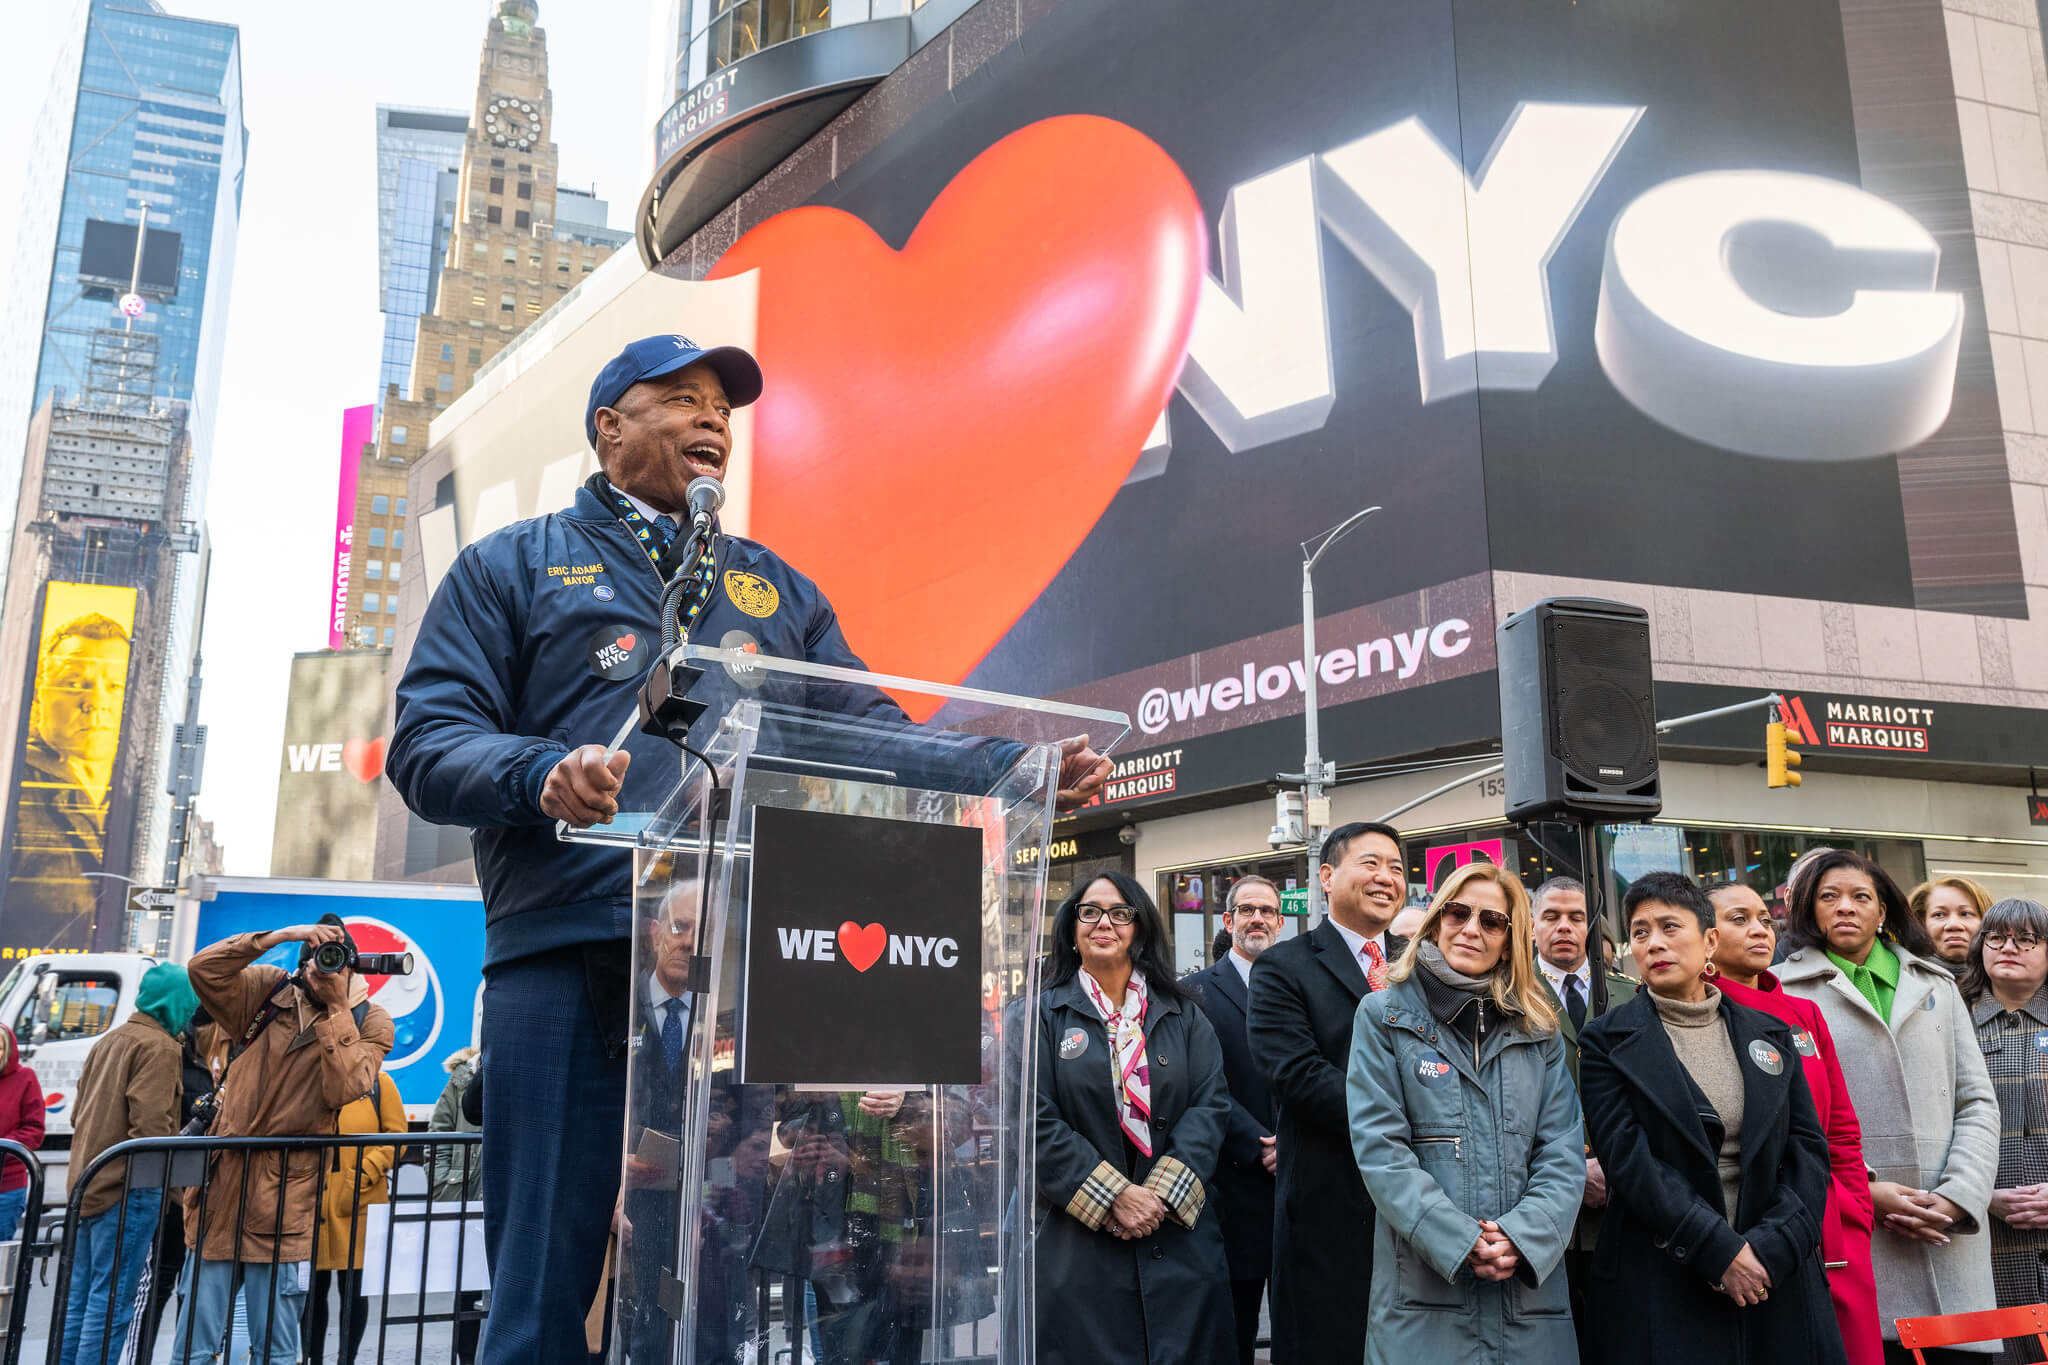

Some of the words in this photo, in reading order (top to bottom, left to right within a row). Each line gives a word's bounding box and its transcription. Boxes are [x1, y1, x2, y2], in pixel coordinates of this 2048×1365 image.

[662, 68, 738, 132] MARRIOTT
[661, 96, 725, 154] MARQUIS
[1120, 101, 1964, 463] NYC
[547, 565, 570, 577] ERIC
[571, 563, 604, 576] ADAMS
[562, 575, 596, 586] MAYOR
[595, 643, 621, 660] WE
[599, 650, 630, 670] NYC
[1137, 618, 1472, 735] @welovenyc
[1827, 702, 1934, 726] MARRIOTT
[1830, 725, 1925, 749] MARQUIS
[287, 743, 344, 773] WE
[1106, 773, 1174, 800] MARQUIS
[141, 895, 164, 905] ONE
[1287, 900, 1299, 913] 46
[777, 927, 836, 962] WE
[888, 934, 959, 968] NYC
[1419, 1068, 1439, 1078] NYC
[1421, 1060, 1437, 1070] WE
